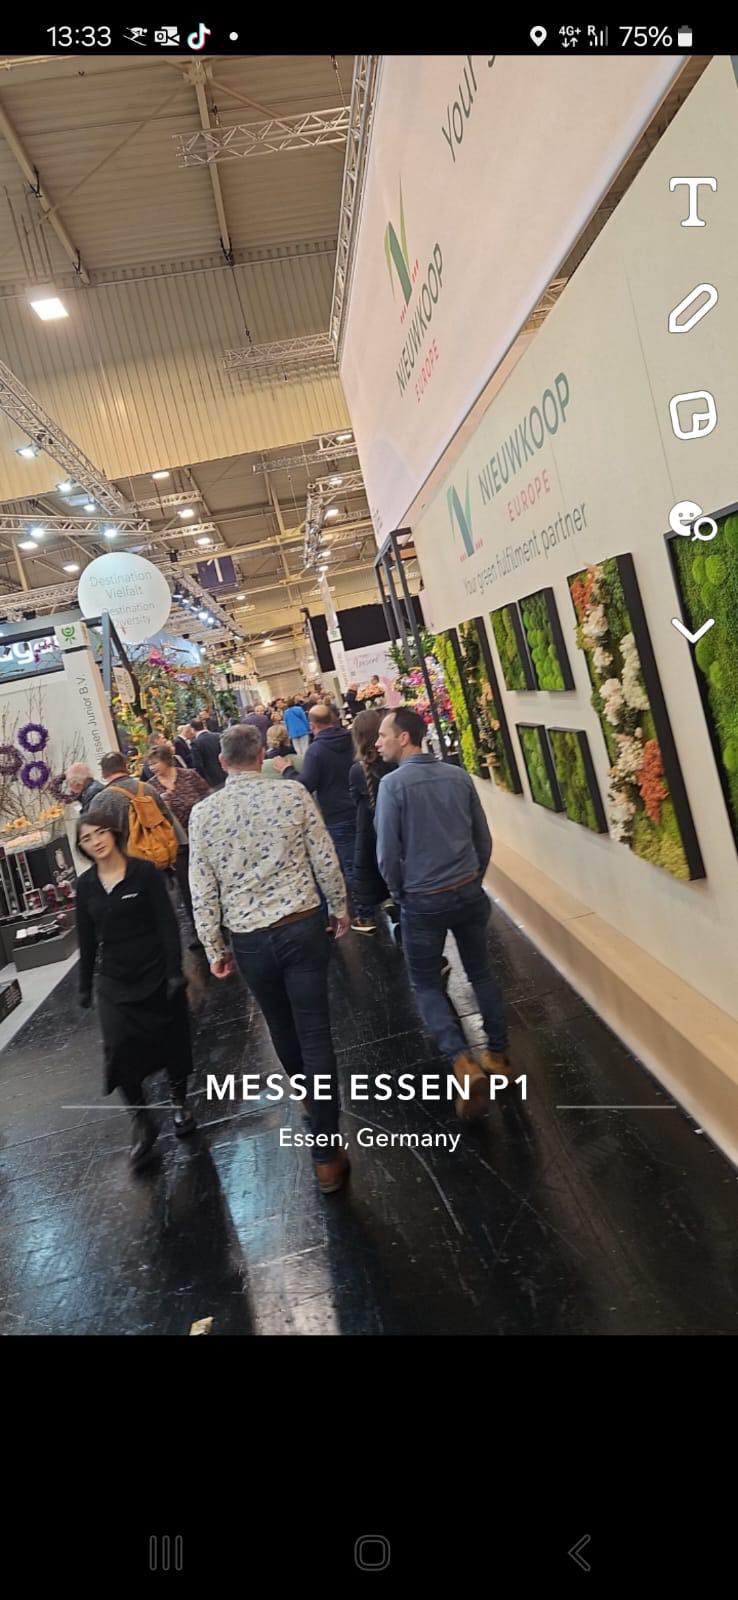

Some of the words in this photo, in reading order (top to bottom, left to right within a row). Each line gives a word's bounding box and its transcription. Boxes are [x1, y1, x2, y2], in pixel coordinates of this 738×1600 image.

[395, 242, 443, 399] NIEUWKOOP
[415, 338, 439, 403] EUROPE
[477, 372, 569, 505] NIEUWKOOP
[506, 469, 551, 522] EUROPE
[90, 568, 152, 587] Destination
[207, 558, 223, 582] 1
[477, 563, 499, 595] green
[540, 503, 588, 560] partner
[83, 697, 97, 726] Junior
